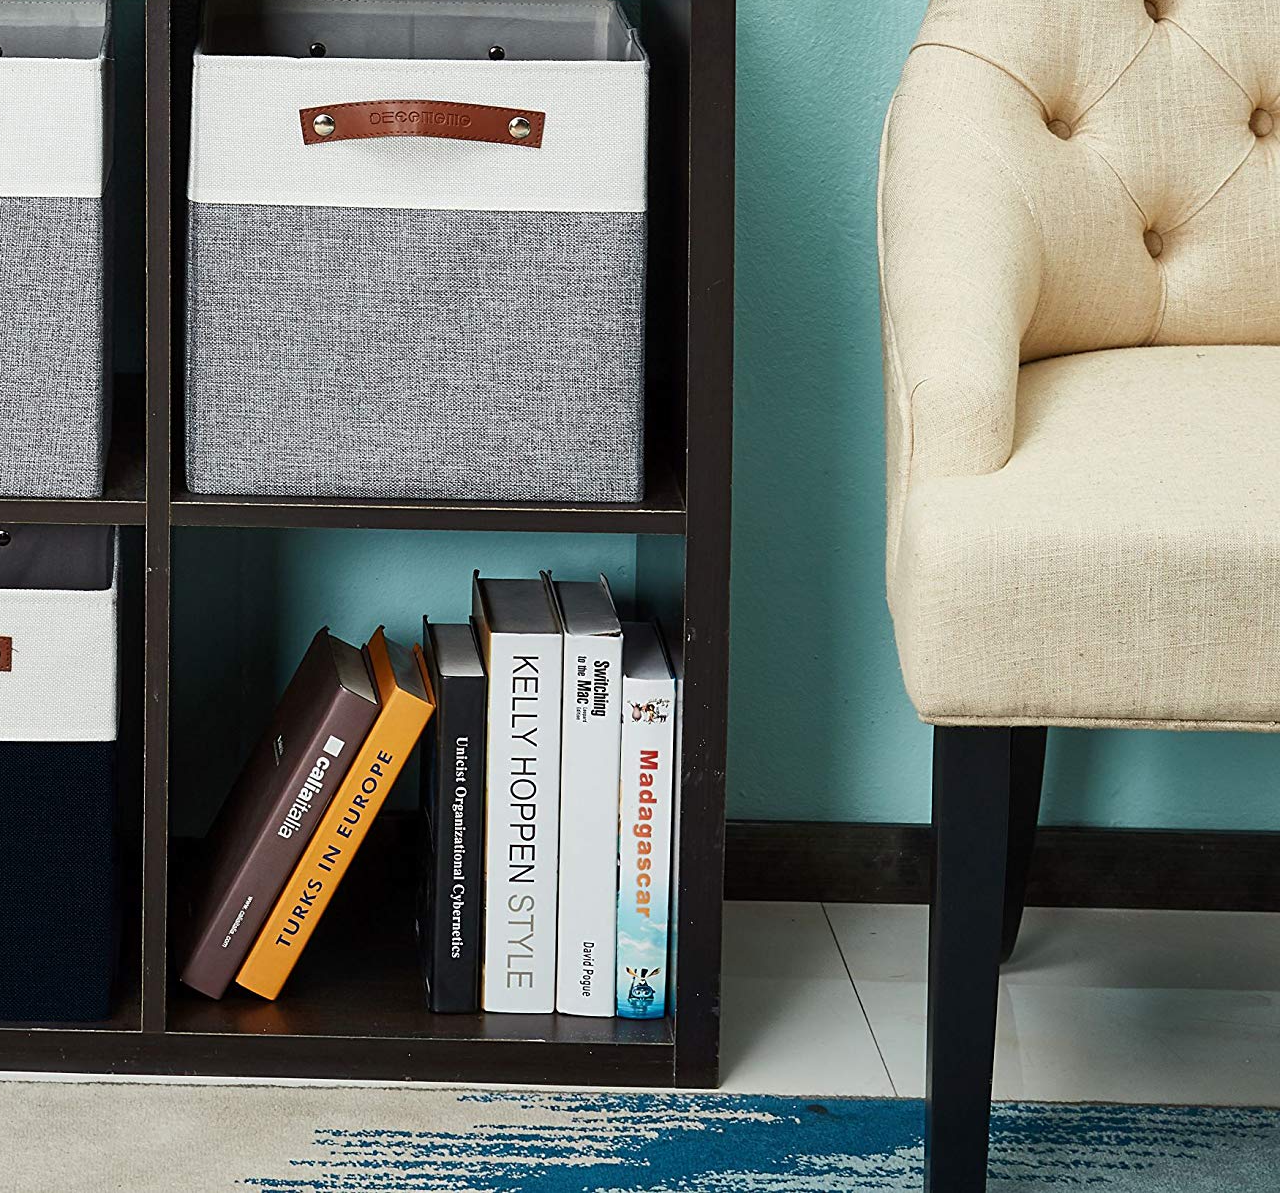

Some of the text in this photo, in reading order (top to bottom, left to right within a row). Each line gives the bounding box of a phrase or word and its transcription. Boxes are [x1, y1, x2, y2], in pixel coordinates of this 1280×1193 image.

[576, 655, 592, 705] to the Mac
[590, 659, 610, 717] Switching
[275, 749, 393, 947] TURKS IN EUROPE
[277, 755, 331, 840] caliaitalia
[449, 736, 469, 959] Unicist Organizational Cybernetics
[506, 655, 539, 989] KELLY HOPPEN STYLE
[631, 749, 660, 919] Madagascar
[579, 941, 595, 997] David Pogue
